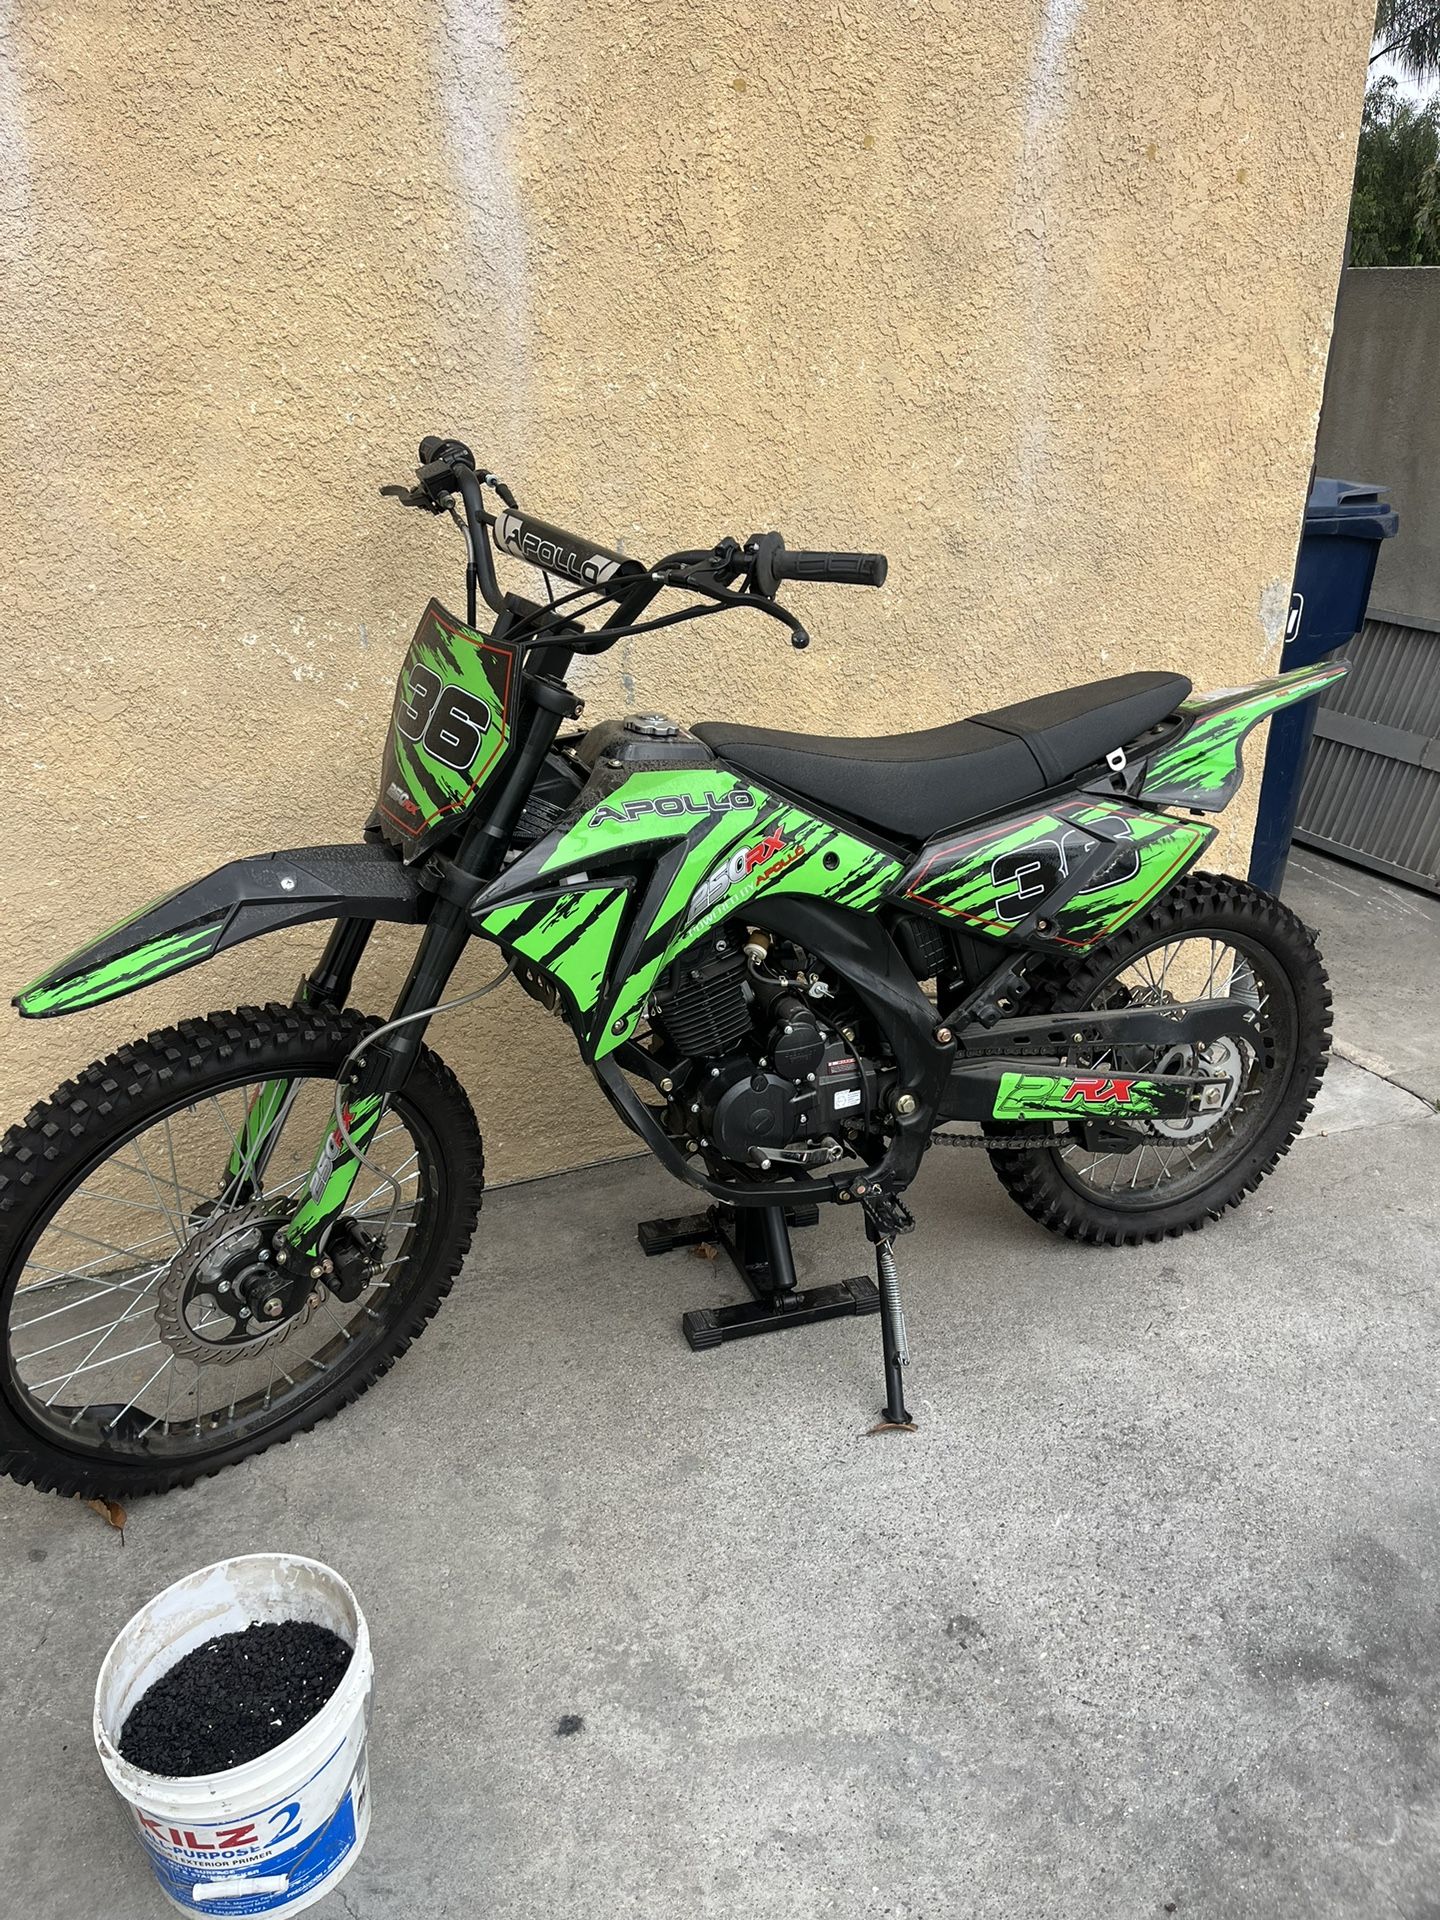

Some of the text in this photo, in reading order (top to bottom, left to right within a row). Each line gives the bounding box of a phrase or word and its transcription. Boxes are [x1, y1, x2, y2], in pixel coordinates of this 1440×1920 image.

[504, 527, 600, 587] APOLLO
[396, 662, 491, 770] 36
[588, 790, 756, 828] APOLLO
[684, 823, 787, 927] 250RX
[755, 844, 806, 887] APOLLO
[136, 1806, 259, 1850] KILZ
[263, 1801, 304, 1849] 2
[180, 1850, 273, 1868] EXTERIOR PRIMER
